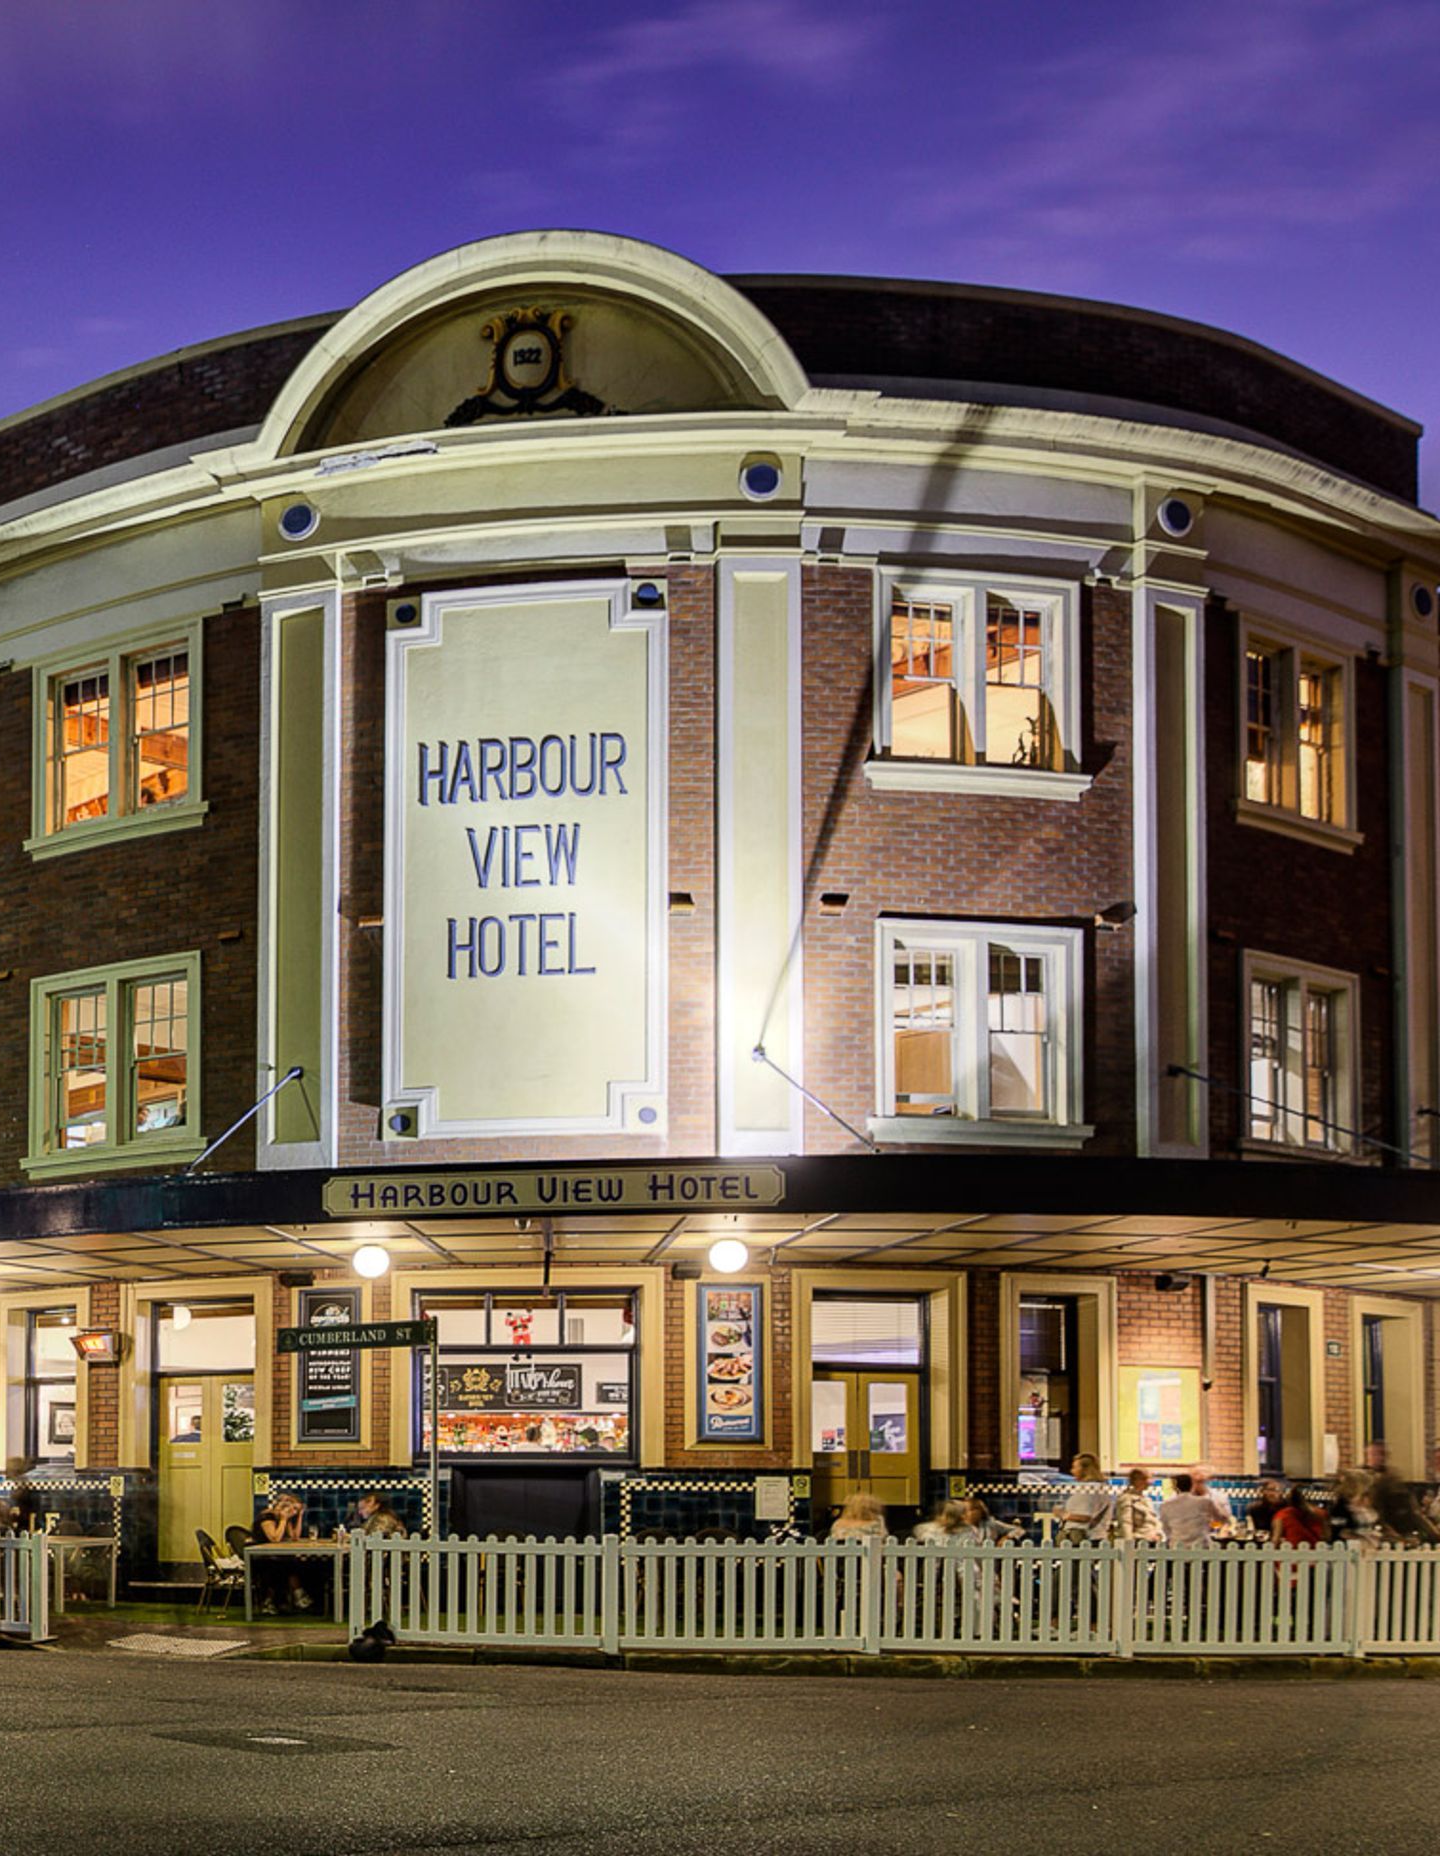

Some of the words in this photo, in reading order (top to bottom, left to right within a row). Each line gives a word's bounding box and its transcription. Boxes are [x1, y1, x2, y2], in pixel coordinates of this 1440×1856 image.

[417, 732, 628, 807] HARBOUR
[465, 822, 581, 889] VIEW
[446, 911, 596, 980] HOTEL
[350, 1181, 518, 1209] HARBOUR
[536, 1176, 624, 1204] VIEW
[648, 1173, 758, 1201] HOTEL
[298, 1329, 387, 1347] CUMBERLAND
[395, 1327, 412, 1341] ST
